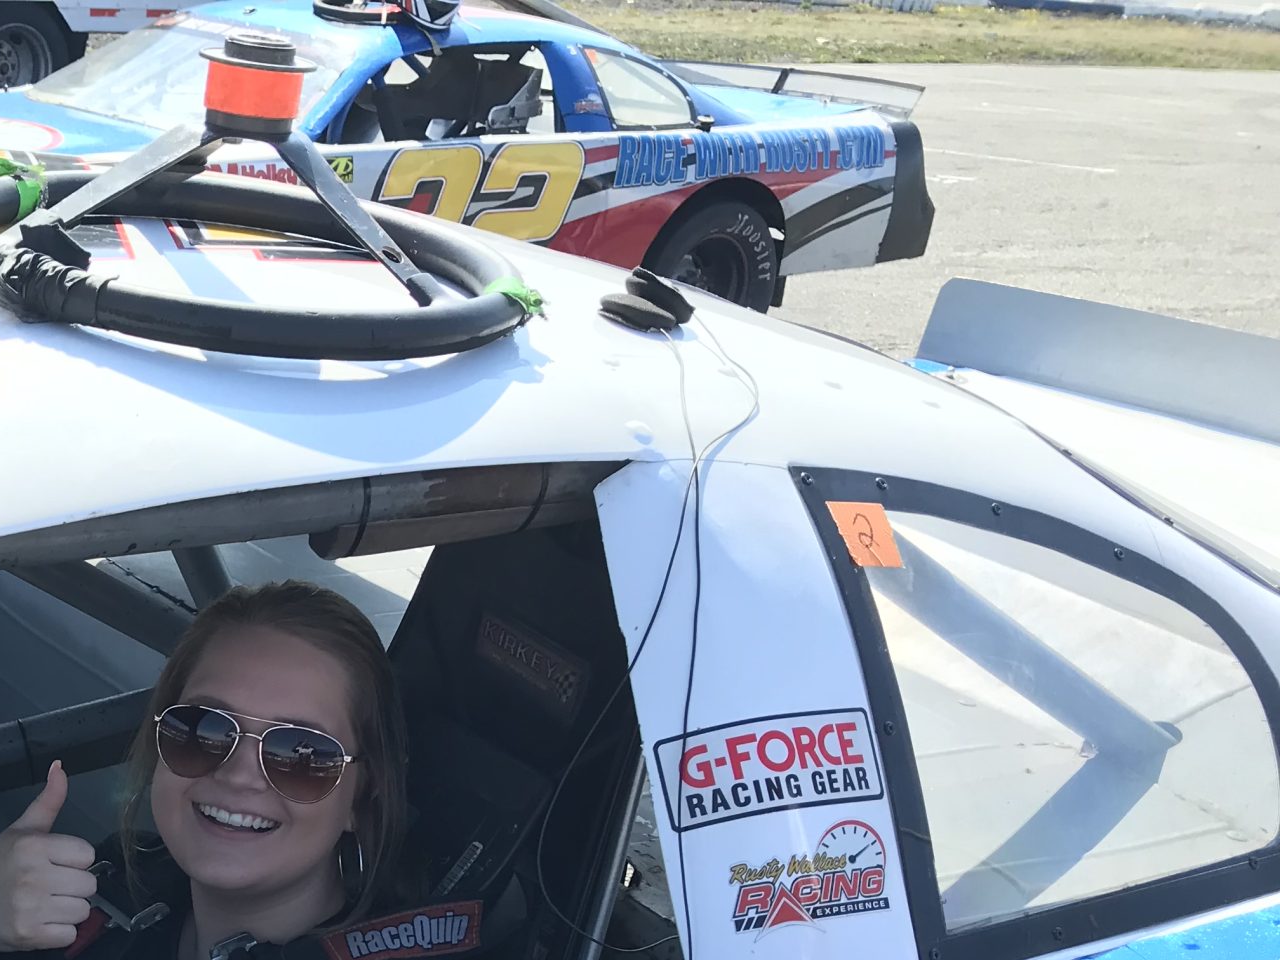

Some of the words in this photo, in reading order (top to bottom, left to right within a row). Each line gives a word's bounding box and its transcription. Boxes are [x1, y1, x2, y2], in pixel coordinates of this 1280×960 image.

[613, 134, 688, 188] RACE
[692, 132, 761, 179] WITH
[761, 128, 832, 173] RUSTY
[852, 512, 879, 548] 2
[679, 721, 864, 789] G-FORCE
[685, 773, 804, 819] RACING
[812, 765, 870, 796] GEAR
[729, 858, 785, 886] Rusty
[787, 852, 847, 877] Wallace
[732, 866, 886, 926] RACING
[816, 900, 886, 917] EXPERIENCE
[346, 911, 470, 959] RaceQuip
